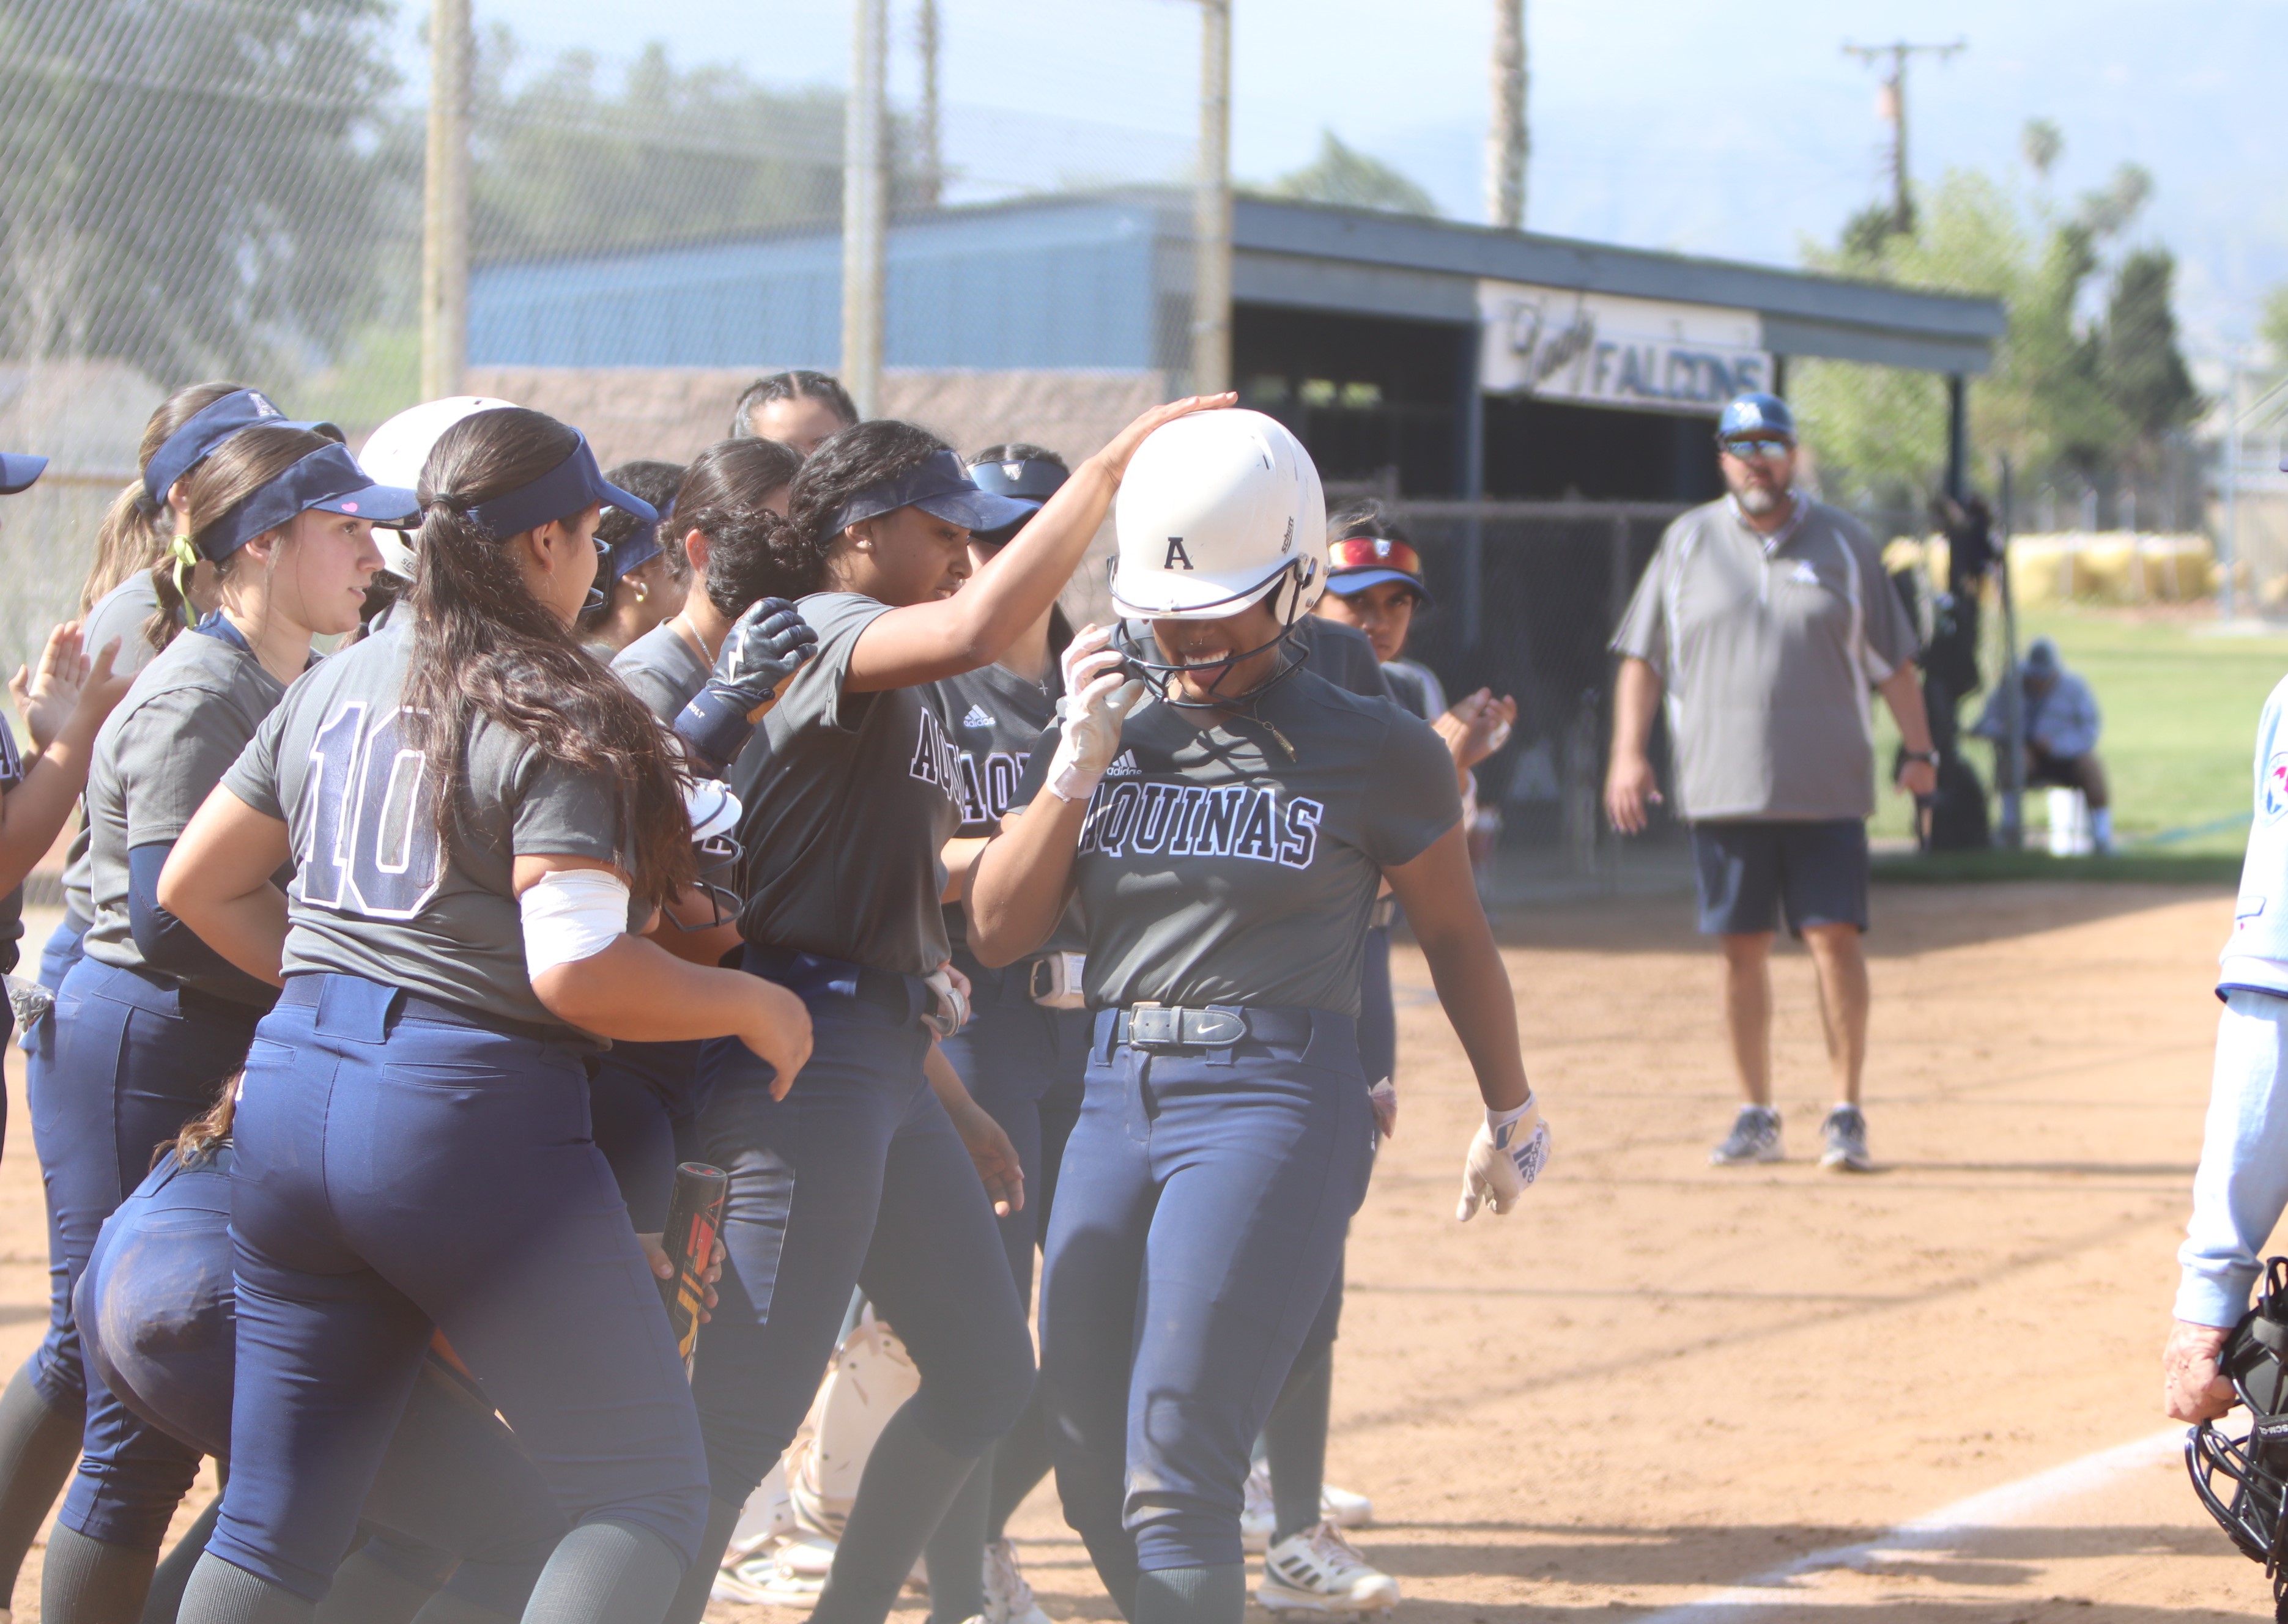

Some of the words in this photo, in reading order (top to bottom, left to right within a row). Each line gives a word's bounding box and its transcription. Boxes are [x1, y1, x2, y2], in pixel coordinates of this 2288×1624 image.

[1164, 537, 1194, 570] A
[963, 717, 996, 728] adidas
[1106, 766, 1142, 777] adidas
[300, 700, 447, 921] 10
[1078, 781, 1324, 870] AQUINAS
[1527, 1132, 1543, 1183] adidas
